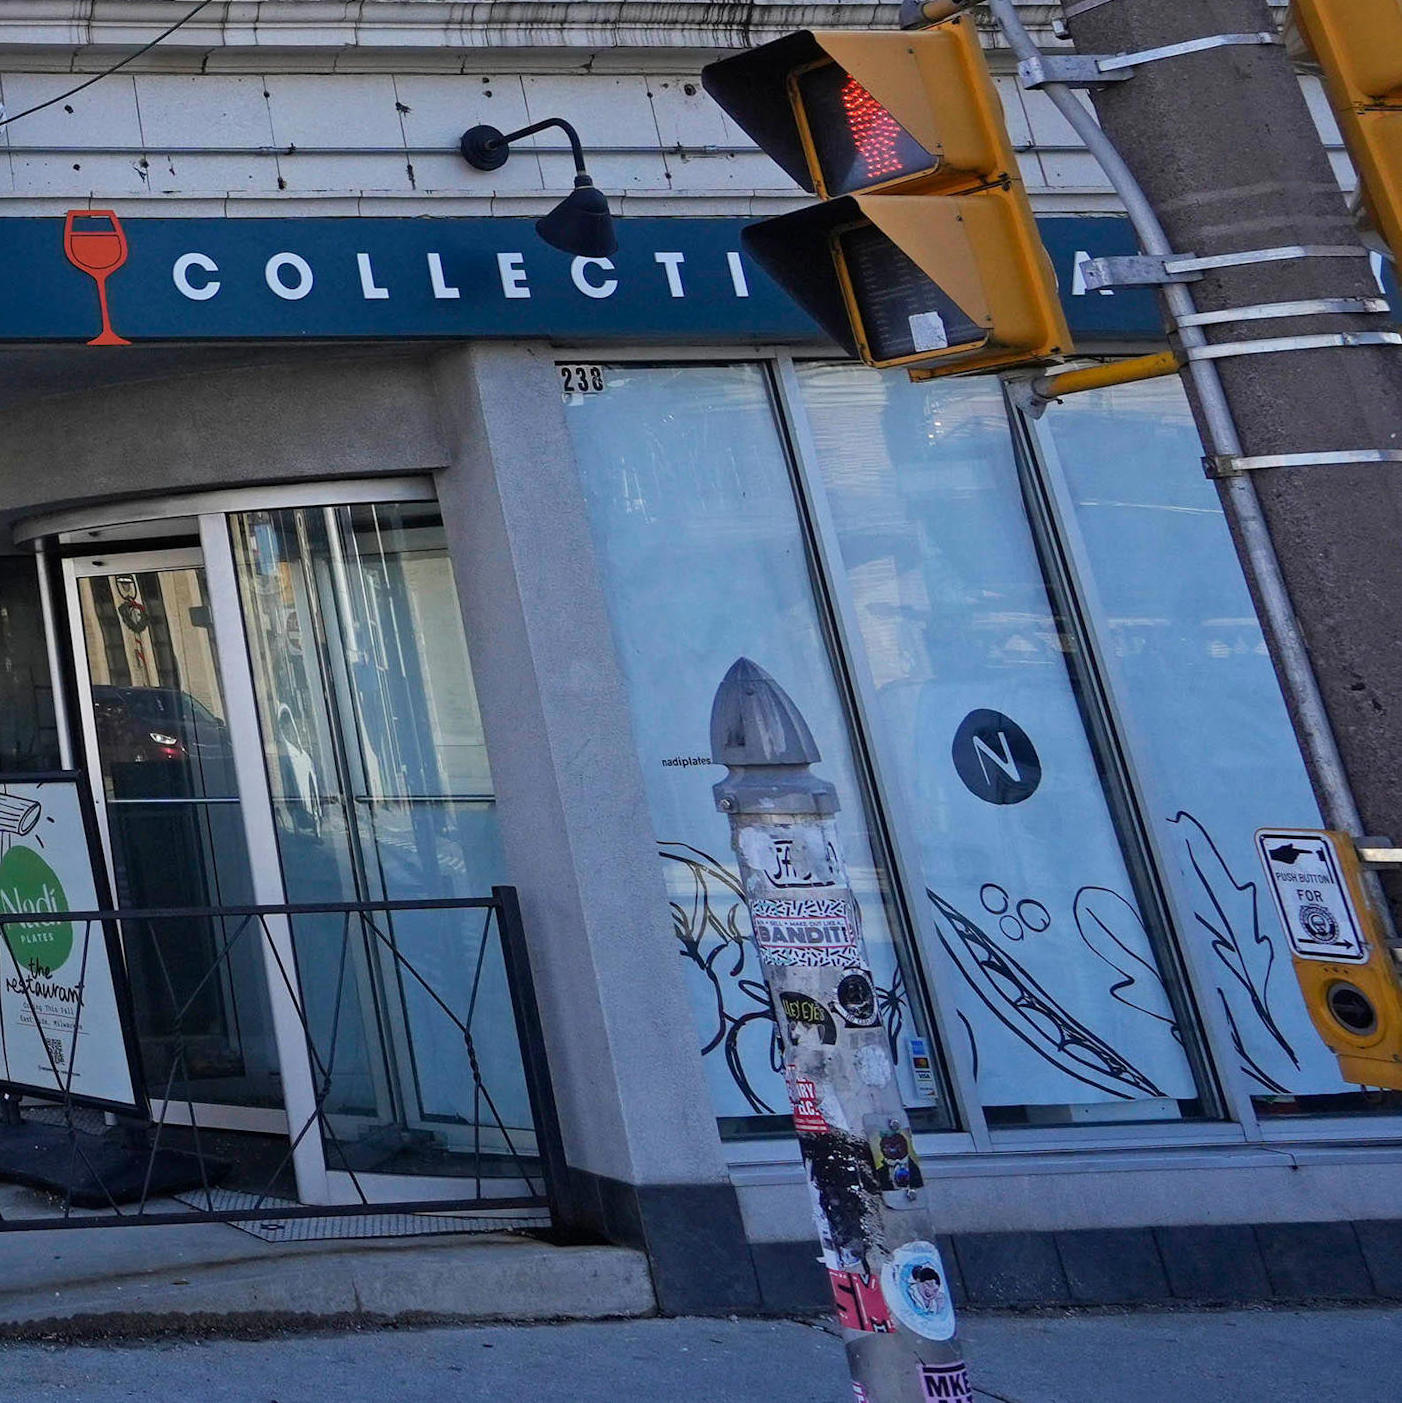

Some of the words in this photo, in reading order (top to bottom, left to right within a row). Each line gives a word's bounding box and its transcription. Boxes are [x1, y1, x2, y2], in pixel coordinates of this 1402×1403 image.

[661, 756, 713, 769] nadiplates.
[1275, 872, 1296, 883] PUSH
[1298, 872, 1330, 885] BUTTON
[1296, 889, 1324, 903] FOR
[20, 932, 55, 944] PLATES
[29, 957, 52, 980] the
[6, 977, 84, 1007] restaurant
